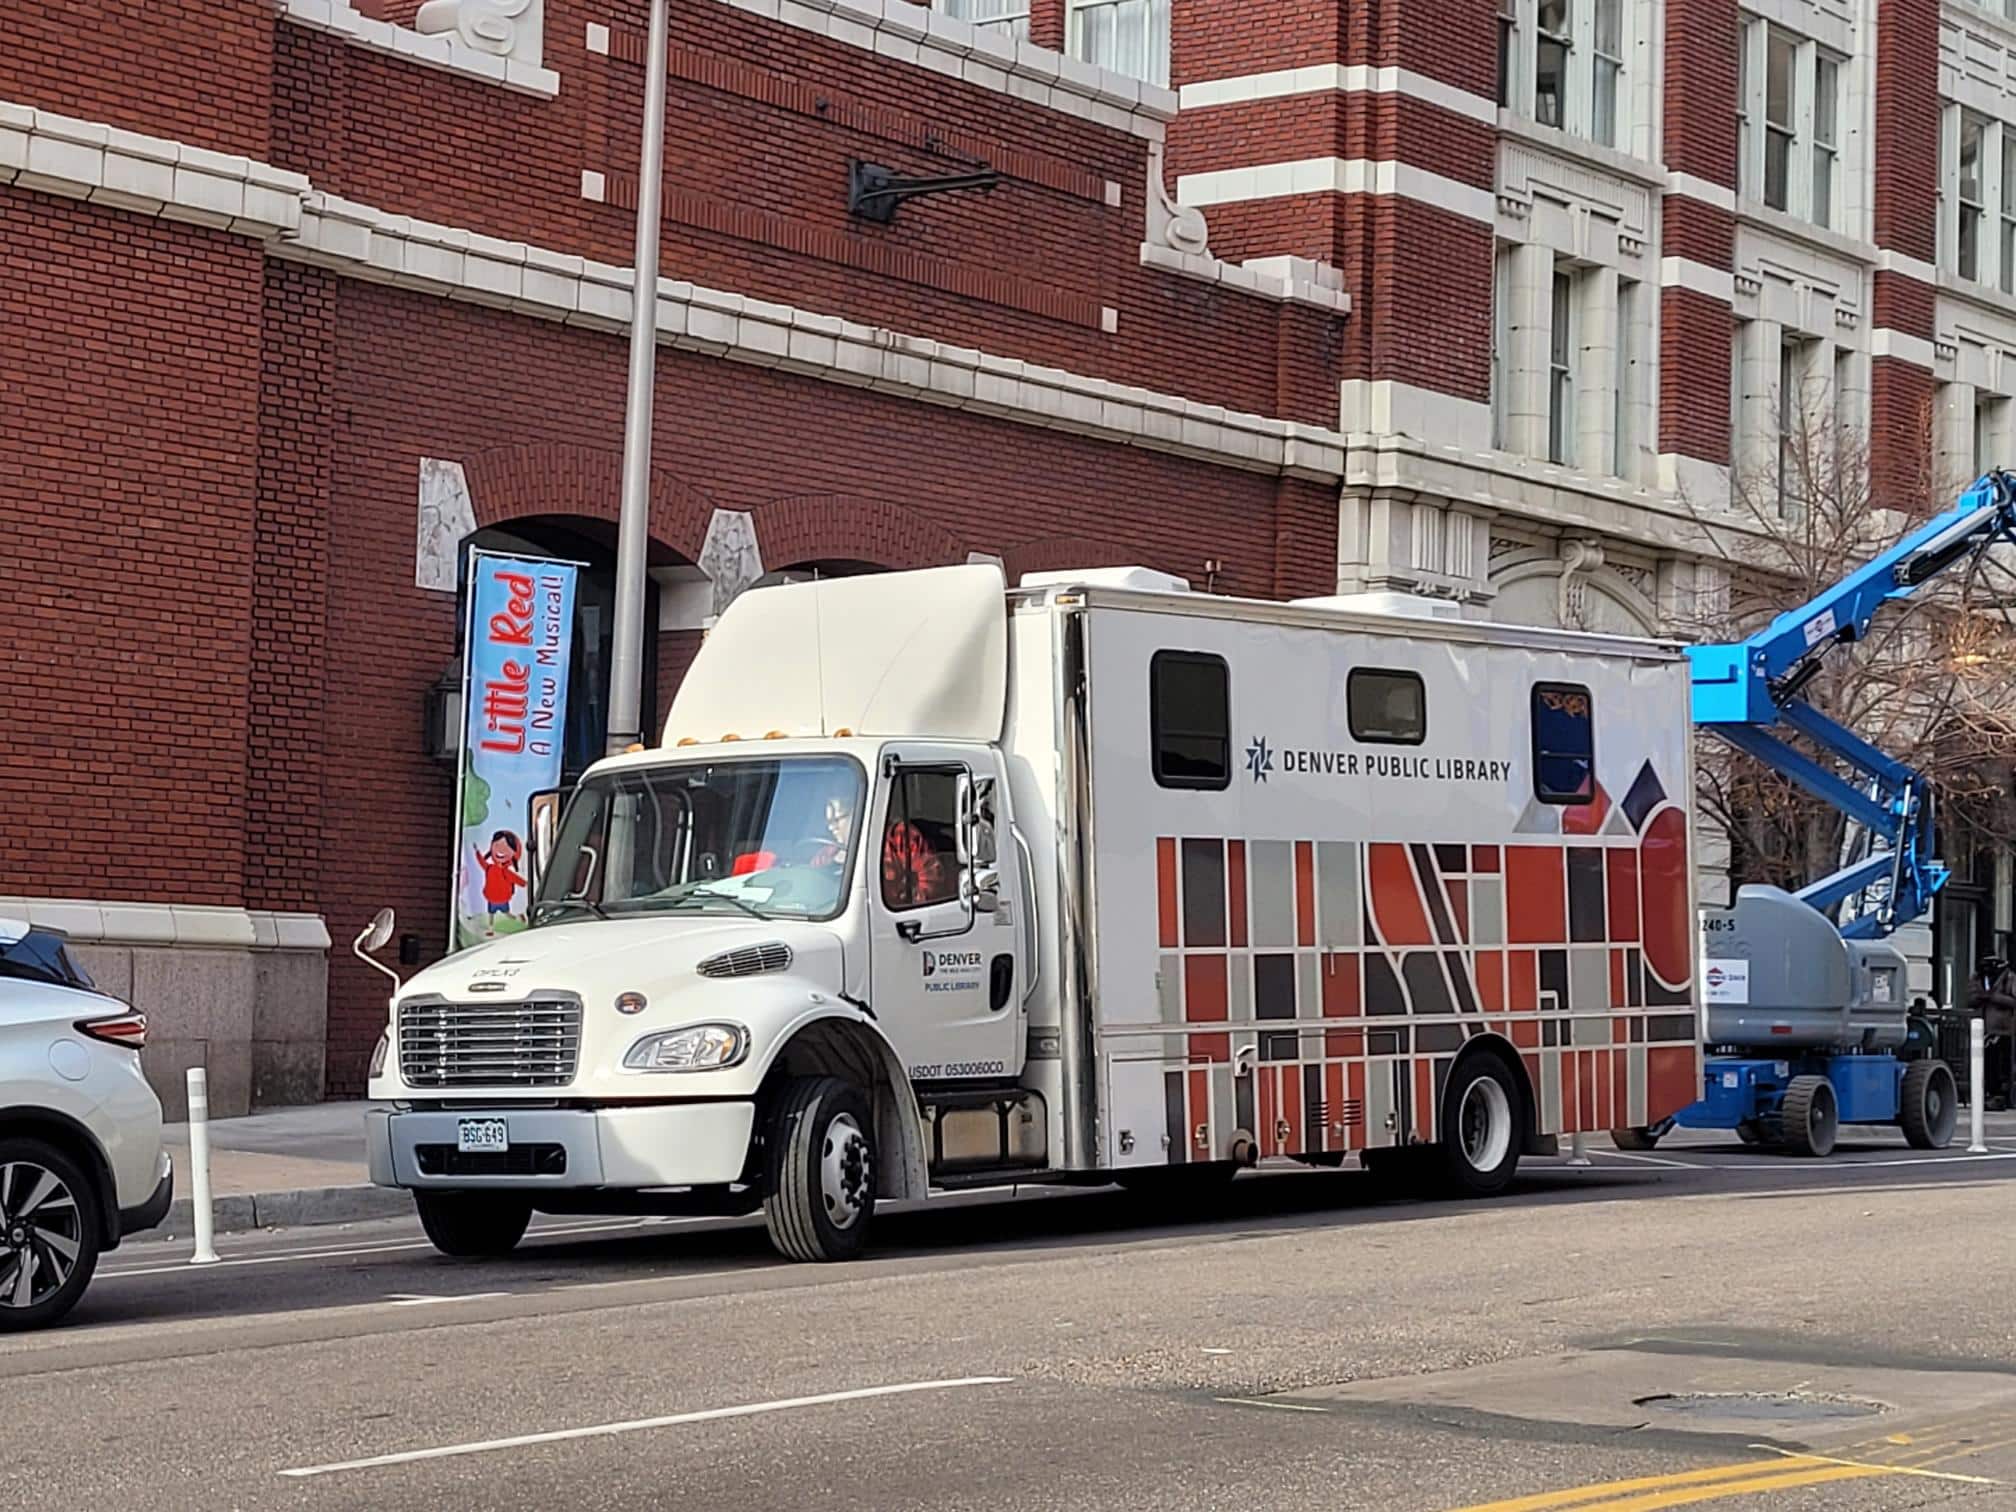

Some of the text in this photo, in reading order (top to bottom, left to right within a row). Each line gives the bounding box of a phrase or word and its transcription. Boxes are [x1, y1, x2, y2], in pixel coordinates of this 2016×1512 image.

[480, 571, 536, 756] Little Red
[529, 575, 565, 756] A New Musical!
[1284, 750, 1511, 782] DENVER PUBLIC LIBRARY
[938, 952, 982, 967] DENVER
[924, 982, 950, 993] PUBLIC
[907, 1064, 942, 1078] USDOT
